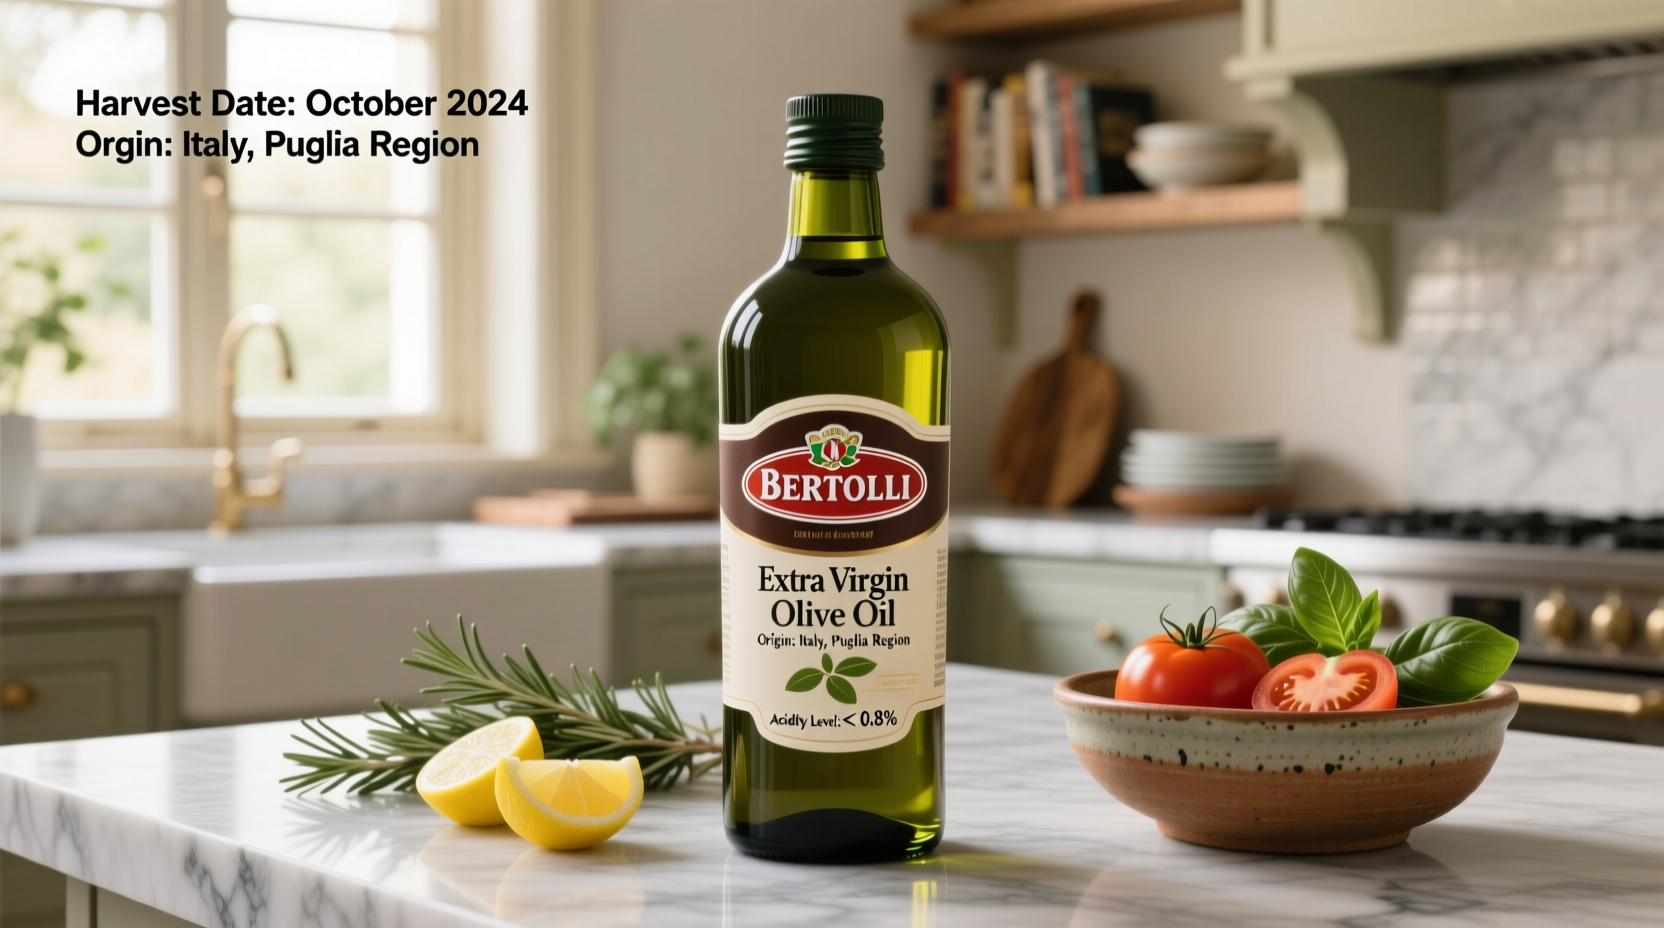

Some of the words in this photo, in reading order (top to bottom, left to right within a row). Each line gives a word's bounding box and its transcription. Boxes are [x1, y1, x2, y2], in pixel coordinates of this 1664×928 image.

[760, 468, 911, 502] BERTOLLI
[757, 565, 825, 593] Extra
[829, 565, 910, 601] Virgin
[771, 599, 846, 628] Olive
[852, 599, 896, 628] Oil
[757, 633, 796, 650] Origin:
[799, 633, 828, 651] Italy,
[831, 633, 868, 650] Puglia
[872, 633, 910, 650] Region
[810, 714, 842, 728] Level:
[859, 709, 898, 727] 0.8%
